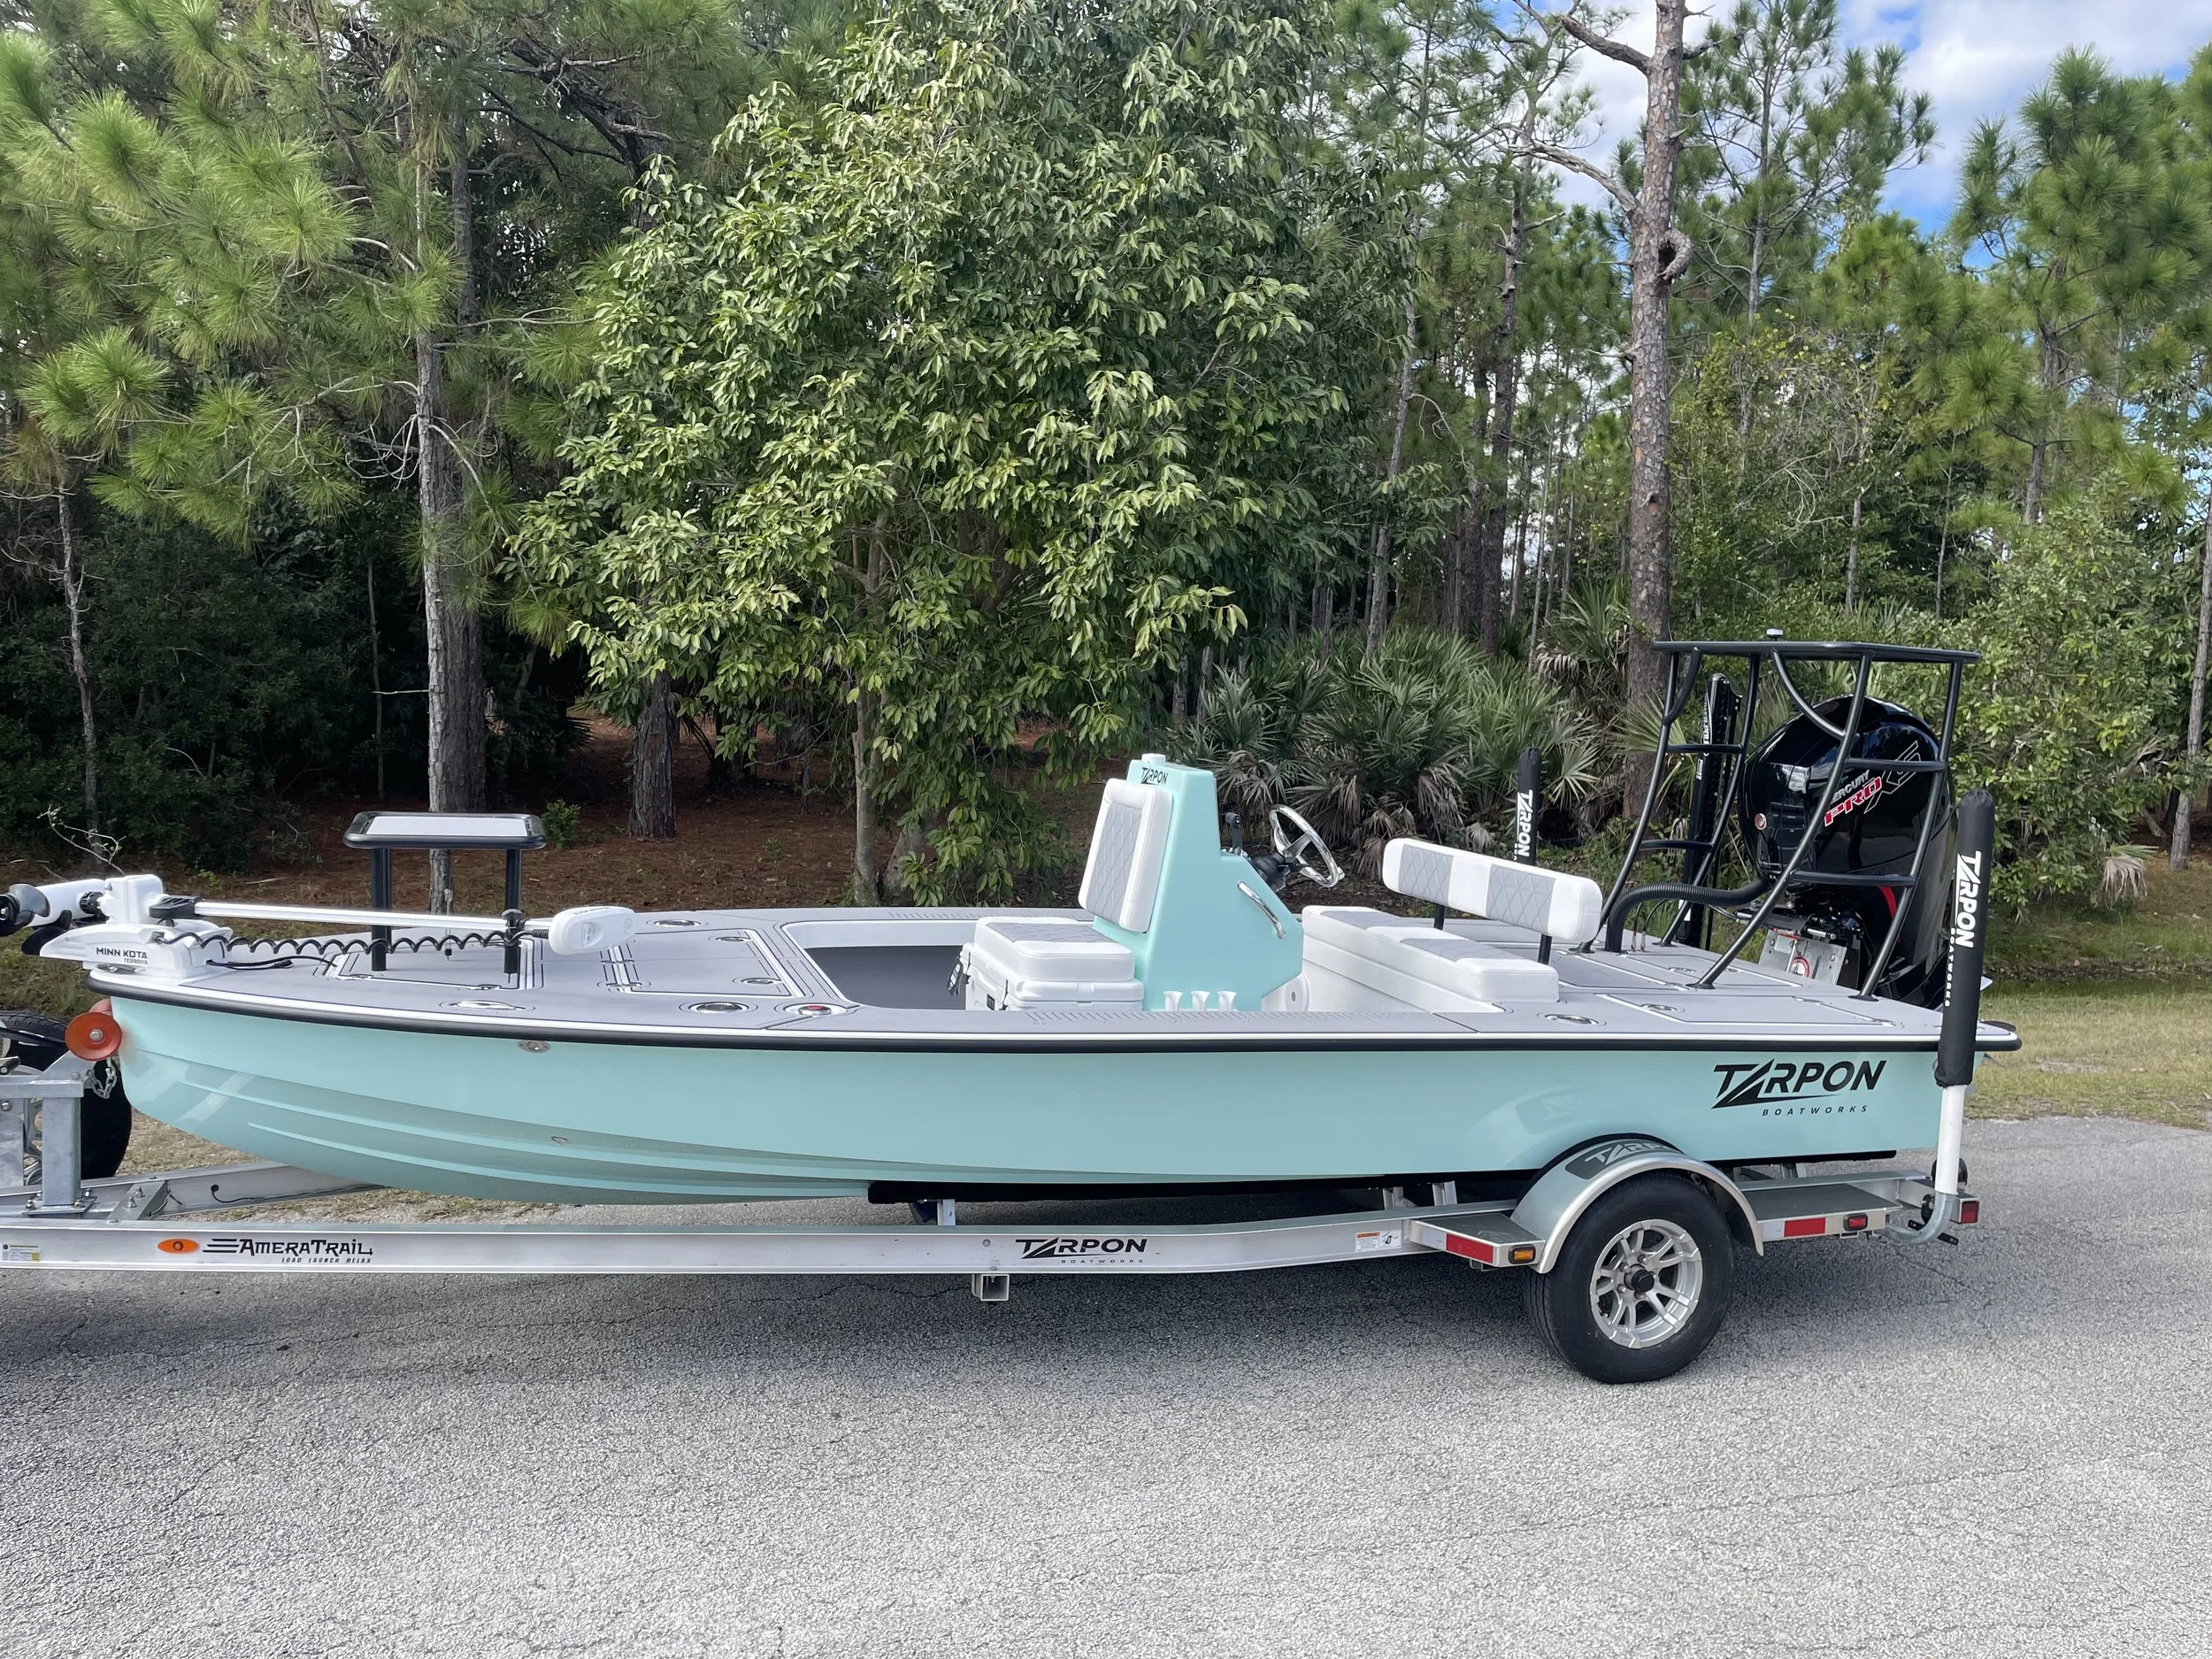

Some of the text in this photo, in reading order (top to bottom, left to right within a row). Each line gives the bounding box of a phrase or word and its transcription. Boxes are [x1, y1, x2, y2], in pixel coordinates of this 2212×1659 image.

[1140, 767, 1169, 786] TARPON
[1824, 776, 1882, 827] PRO
[1517, 789, 1533, 857] TARPON
[1955, 850, 1982, 949] TARPON
[96, 947, 148, 959] MINN KOTA
[1710, 1058, 1887, 1110] TARPON
[1762, 1105, 1868, 1117] BOATWORKS
[1015, 1237, 1148, 1260] TARPON
